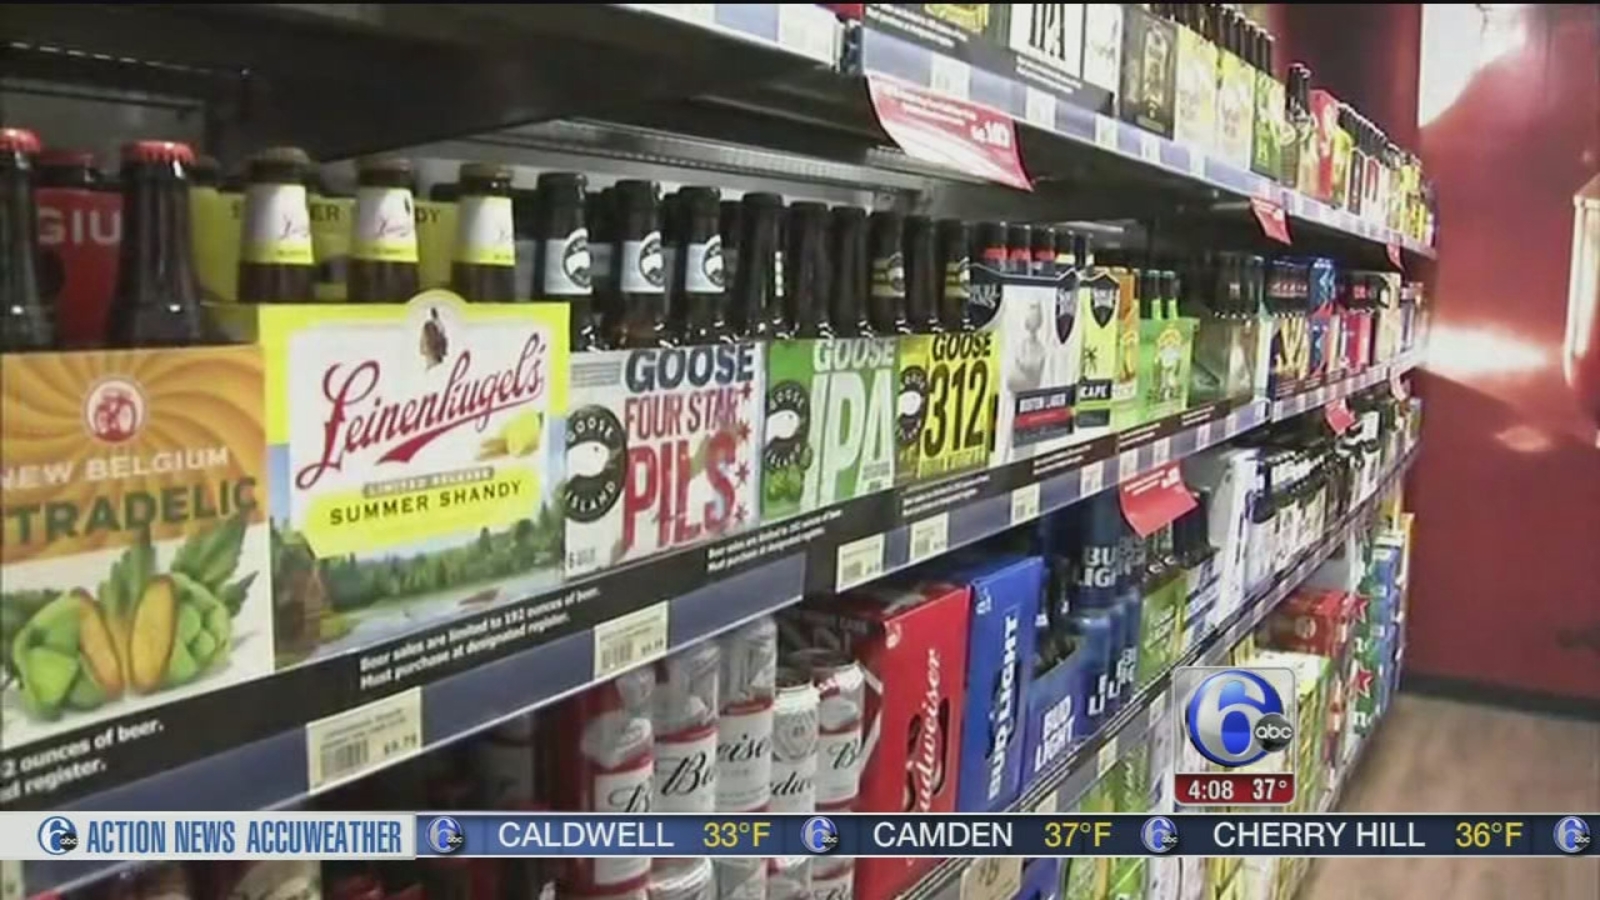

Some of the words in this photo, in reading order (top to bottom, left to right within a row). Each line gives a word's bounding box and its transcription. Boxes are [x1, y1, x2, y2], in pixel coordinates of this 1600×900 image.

[625, 343, 754, 393] GOOSE
[814, 337, 896, 372] GOOSE
[932, 332, 992, 362] GOOSE
[296, 332, 546, 490] Leinenkugel's
[625, 394, 682, 440] FOUR
[924, 360, 989, 457] 312
[85, 446, 229, 483] BELGIUM
[330, 496, 430, 525] SUMMER
[440, 481, 522, 506] SHANDY
[621, 430, 737, 557] PILS
[20, 738, 91, 772] ounces
[94, 727, 114, 749] of
[117, 719, 165, 743] beer.
[24, 758, 107, 795] register.
